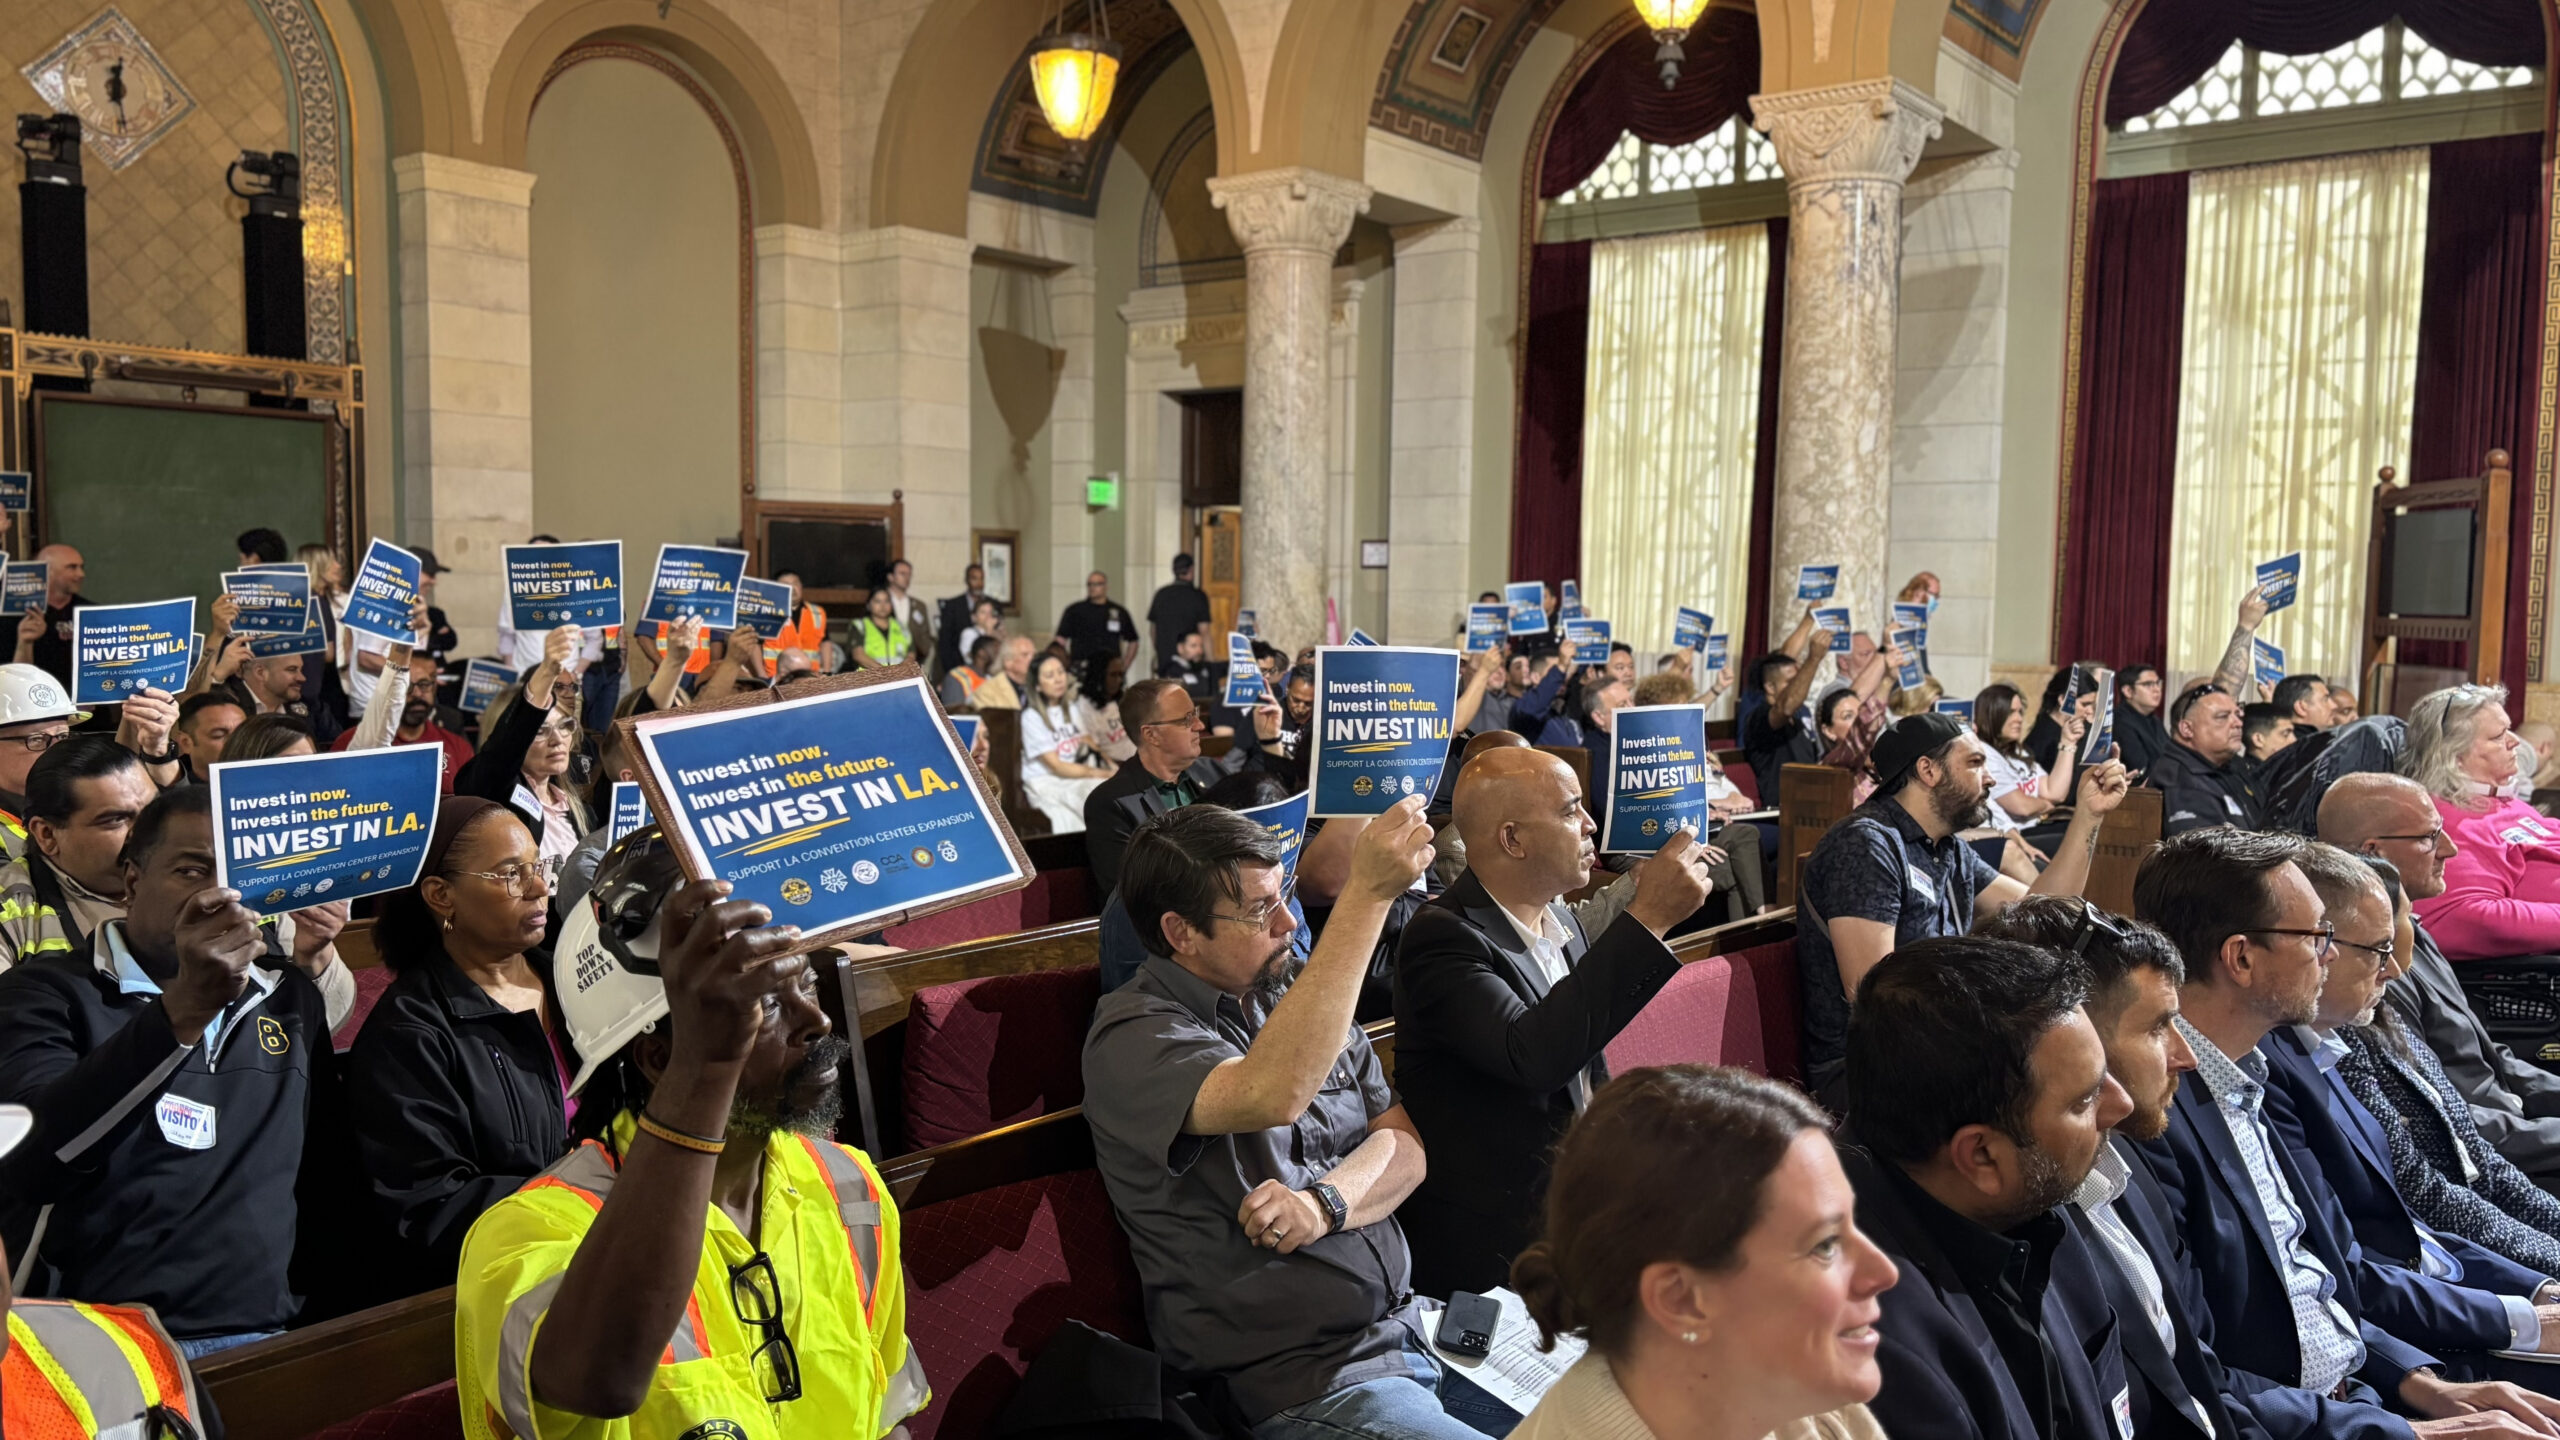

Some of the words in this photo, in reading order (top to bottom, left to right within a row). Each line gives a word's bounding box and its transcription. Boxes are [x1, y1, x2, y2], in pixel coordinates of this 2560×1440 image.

[359, 576, 396, 597] INVEST
[394, 588, 406, 601] IN
[404, 592, 418, 605] LA
[512, 580, 572, 594] INVEST
[576, 578, 590, 592] IN
[593, 576, 617, 590] LA.
[658, 577, 701, 590] INVEST
[702, 579, 714, 591] IN
[715, 581, 734, 592] LA.
[275, 597, 286, 607] IN
[288, 598, 306, 608] LA.
[84, 626, 116, 634] Invest
[118, 624, 128, 632] in
[84, 636, 116, 645] Invest
[118, 635, 128, 643] in
[129, 634, 145, 642] the
[146, 632, 172, 640] future.
[83, 644, 150, 662] INVEST
[154, 642, 168, 656] IN
[169, 638, 188, 654] LA.
[1329, 680, 1372, 694] Invest
[1374, 680, 1386, 692] in
[1388, 682, 1414, 692] now.
[1328, 700, 1372, 712] Invest
[1374, 698, 1386, 712] in
[1388, 699, 1407, 711] the
[1409, 699, 1438, 711] future.
[1328, 718, 1414, 740] INVEST
[1418, 718, 1432, 739] IN
[1434, 718, 1449, 738] LA.
[1622, 736, 1656, 749] Invest
[1657, 735, 1666, 746] in
[1666, 736, 1682, 746] now.
[678, 757, 751, 786] Invest
[750, 754, 774, 772] in
[776, 744, 829, 767] now.
[1377, 758, 1418, 767] CONVENTION
[1622, 752, 1657, 765] Invest
[1658, 751, 1667, 762] in
[1668, 750, 1679, 761] the
[688, 781, 763, 810] Invest
[762, 777, 786, 794] in
[785, 769, 824, 789] the
[824, 754, 895, 781] future.
[1620, 766, 1684, 790] INVEST
[1686, 765, 1694, 784] IN
[1694, 764, 1704, 782] LA.
[230, 794, 287, 810] Invest
[290, 791, 306, 804] in
[310, 788, 351, 802] now.
[619, 803, 640, 811] Inves
[700, 786, 848, 847] INVEST
[852, 776, 898, 810] IN
[894, 767, 959, 801] LA.
[231, 813, 288, 830] Invest
[291, 810, 308, 823] in
[310, 807, 338, 821] the
[341, 800, 393, 817] future.
[618, 814, 640, 822] Inves
[232, 823, 349, 860] INVEST
[353, 818, 381, 842] IN
[385, 812, 426, 836] LA.
[1267, 822, 1282, 832] now.
[1277, 828, 1295, 839] future.
[727, 860, 782, 882] SUPPORT
[784, 855, 801, 868] LA
[801, 834, 876, 863] CONVENTION
[876, 824, 918, 843] CENTER
[918, 811, 975, 833] EXPANSION
[1281, 836, 1290, 854] IN
[238, 874, 279, 888] SUPPORT
[281, 873, 292, 881] LA
[293, 861, 346, 879] CONVENTION
[347, 856, 377, 867] CENTER
[378, 845, 420, 860] EXPANSION
[880, 854, 904, 866] CCA
[576, 944, 595, 964] TOP
[576, 951, 604, 980] DOWN
[577, 960, 614, 993] SAFETY
[257, 1016, 290, 1055] 8
[692, 1421, 736, 1436] TAFT
